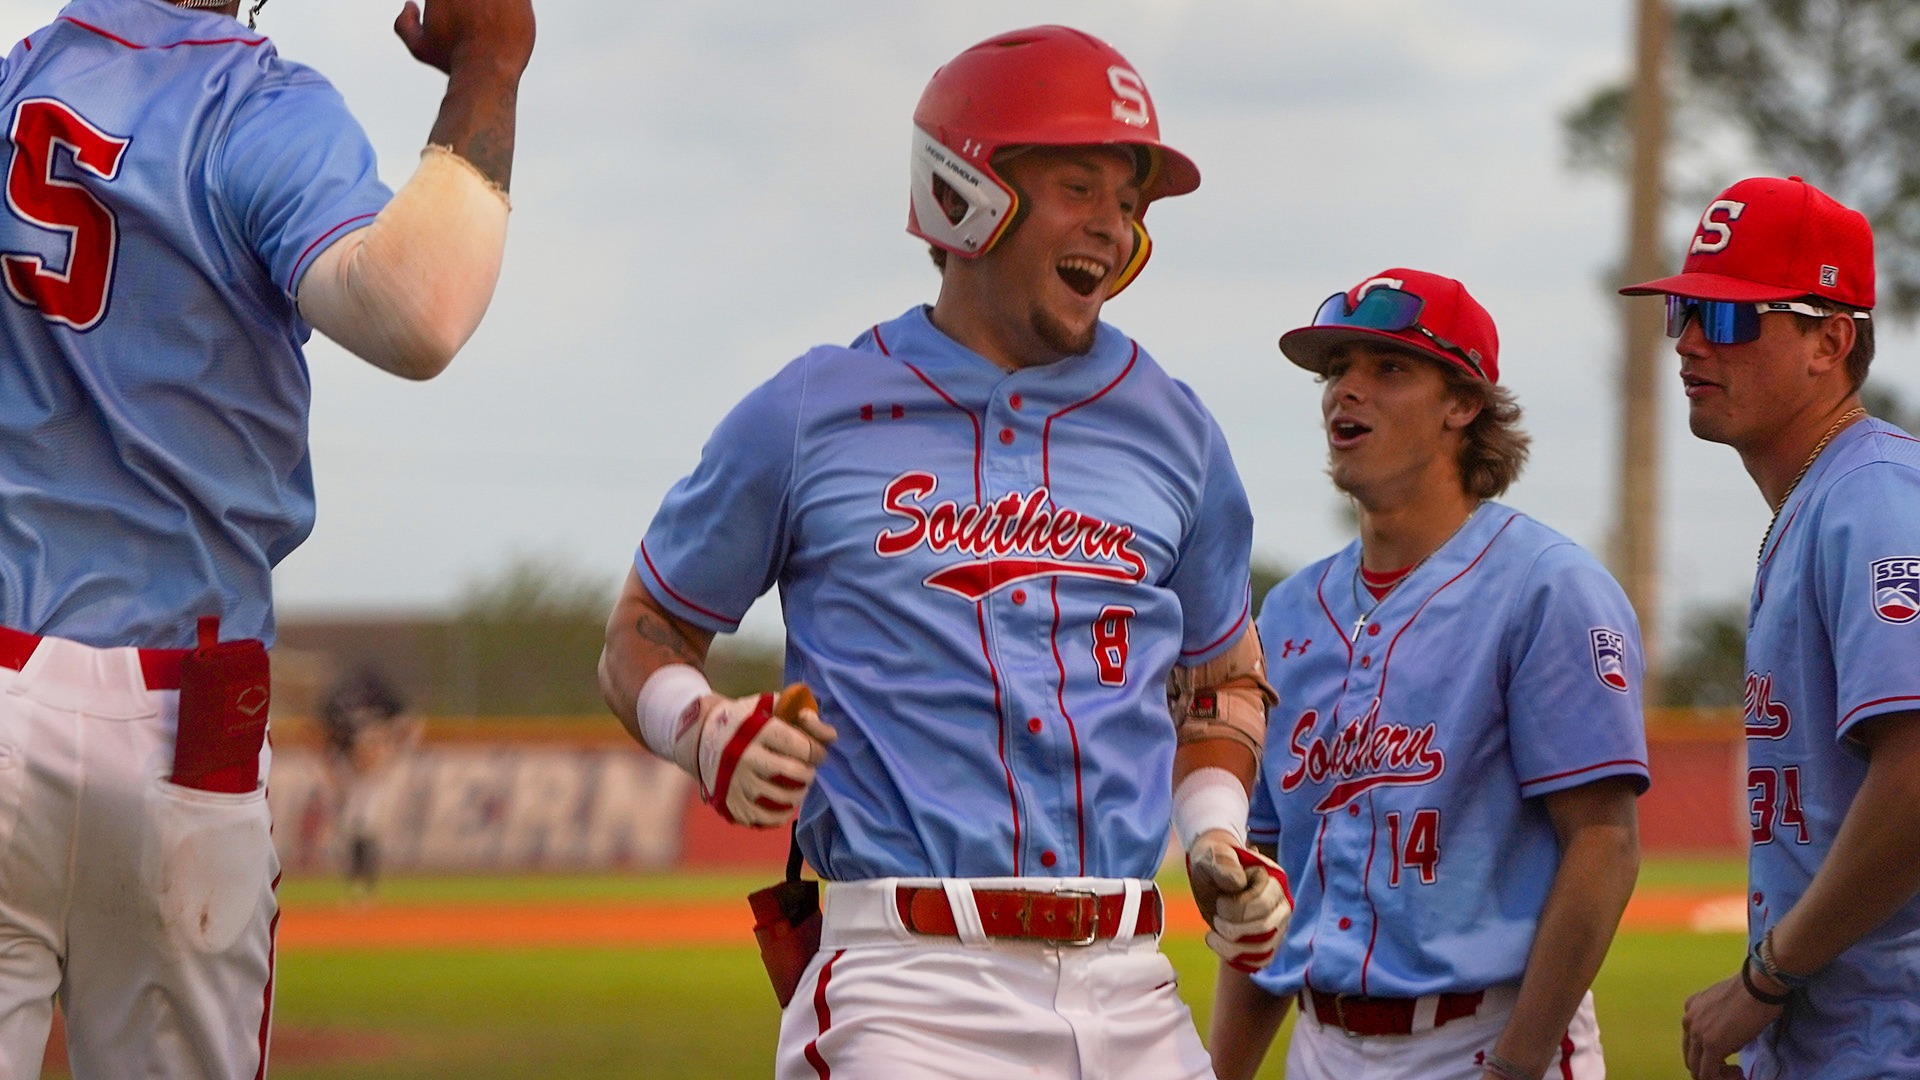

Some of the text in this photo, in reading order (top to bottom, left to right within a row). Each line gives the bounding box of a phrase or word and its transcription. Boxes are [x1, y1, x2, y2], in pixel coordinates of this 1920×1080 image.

[1106, 65, 1150, 128] S
[945, 159, 980, 187] ARMOUR
[0, 96, 133, 334] 5
[1690, 199, 1747, 256] S
[873, 470, 1149, 590] Southern
[1876, 562, 1920, 580] SSC
[1091, 604, 1137, 687] 8
[1279, 695, 1446, 802] Southern
[1746, 765, 1811, 846] 34
[1385, 807, 1442, 888] 14
